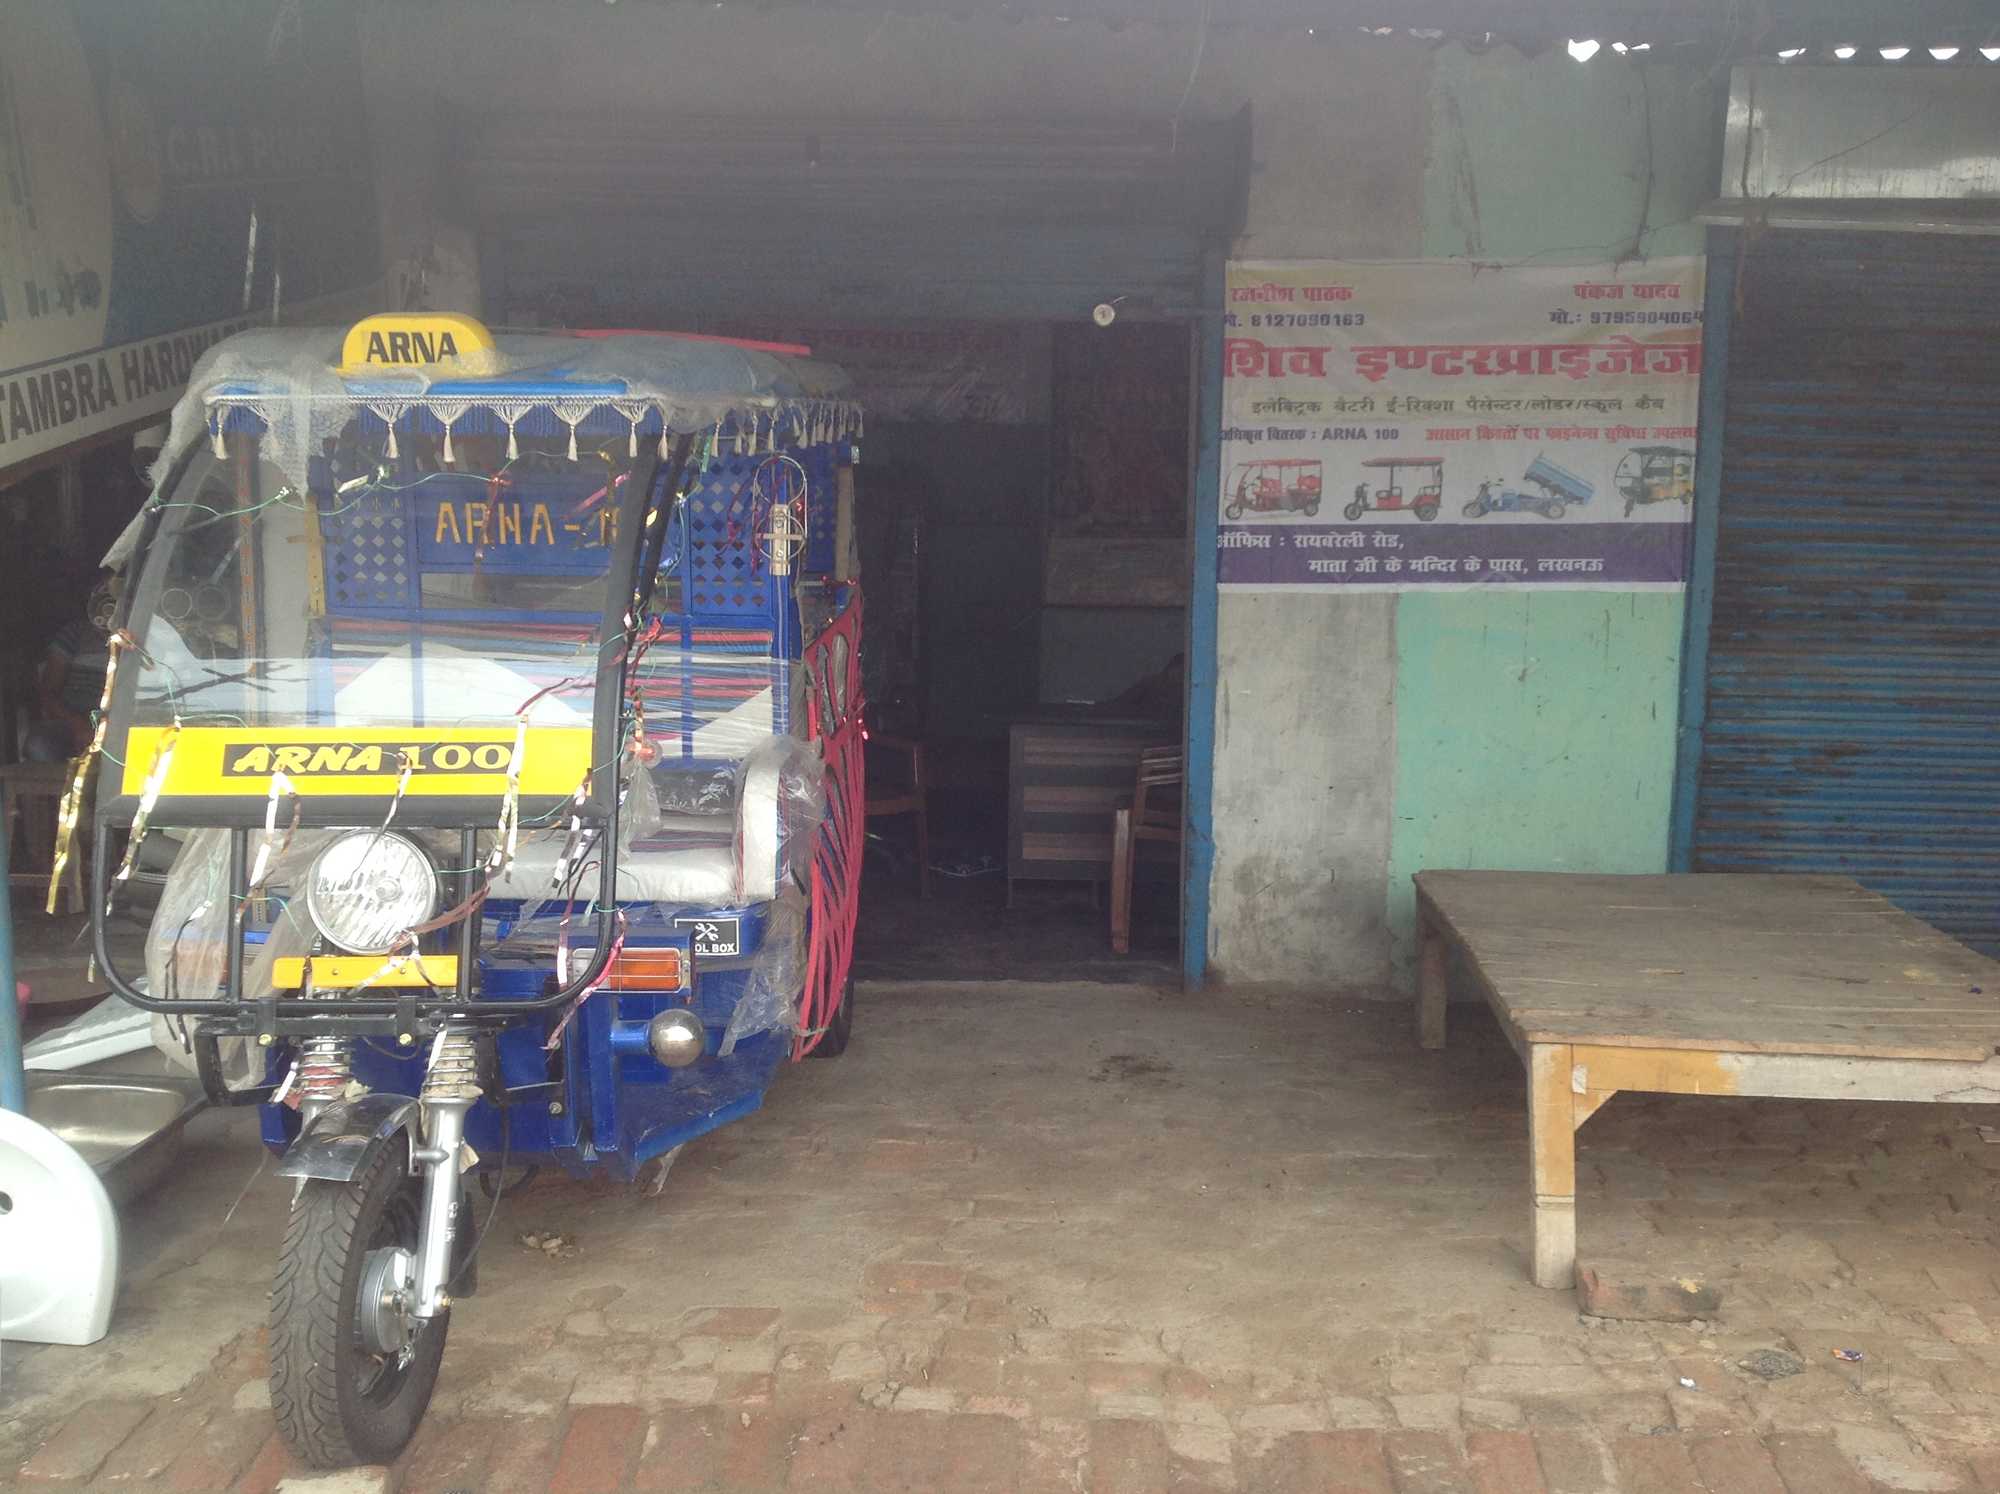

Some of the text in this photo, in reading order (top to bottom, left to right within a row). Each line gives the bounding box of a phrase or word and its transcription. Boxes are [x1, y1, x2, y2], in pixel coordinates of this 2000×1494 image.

[1573, 280, 1682, 299] पंकज यादव
[366, 331, 459, 364] ARNA
[1223, 334, 1703, 382] शिव इण्टरप्राइजेज
[1321, 427, 1369, 441] ARNA
[1375, 427, 1400, 441] 100
[1426, 426, 1472, 441] आसान
[1523, 426, 1541, 441] पर
[1371, 531, 1405, 550] रोड,
[1307, 555, 1605, 576] माता जी के मन्दिर के पास, लखनऊ
[231, 743, 512, 774] ARNA 100
[711, 942, 736, 953] BOX
